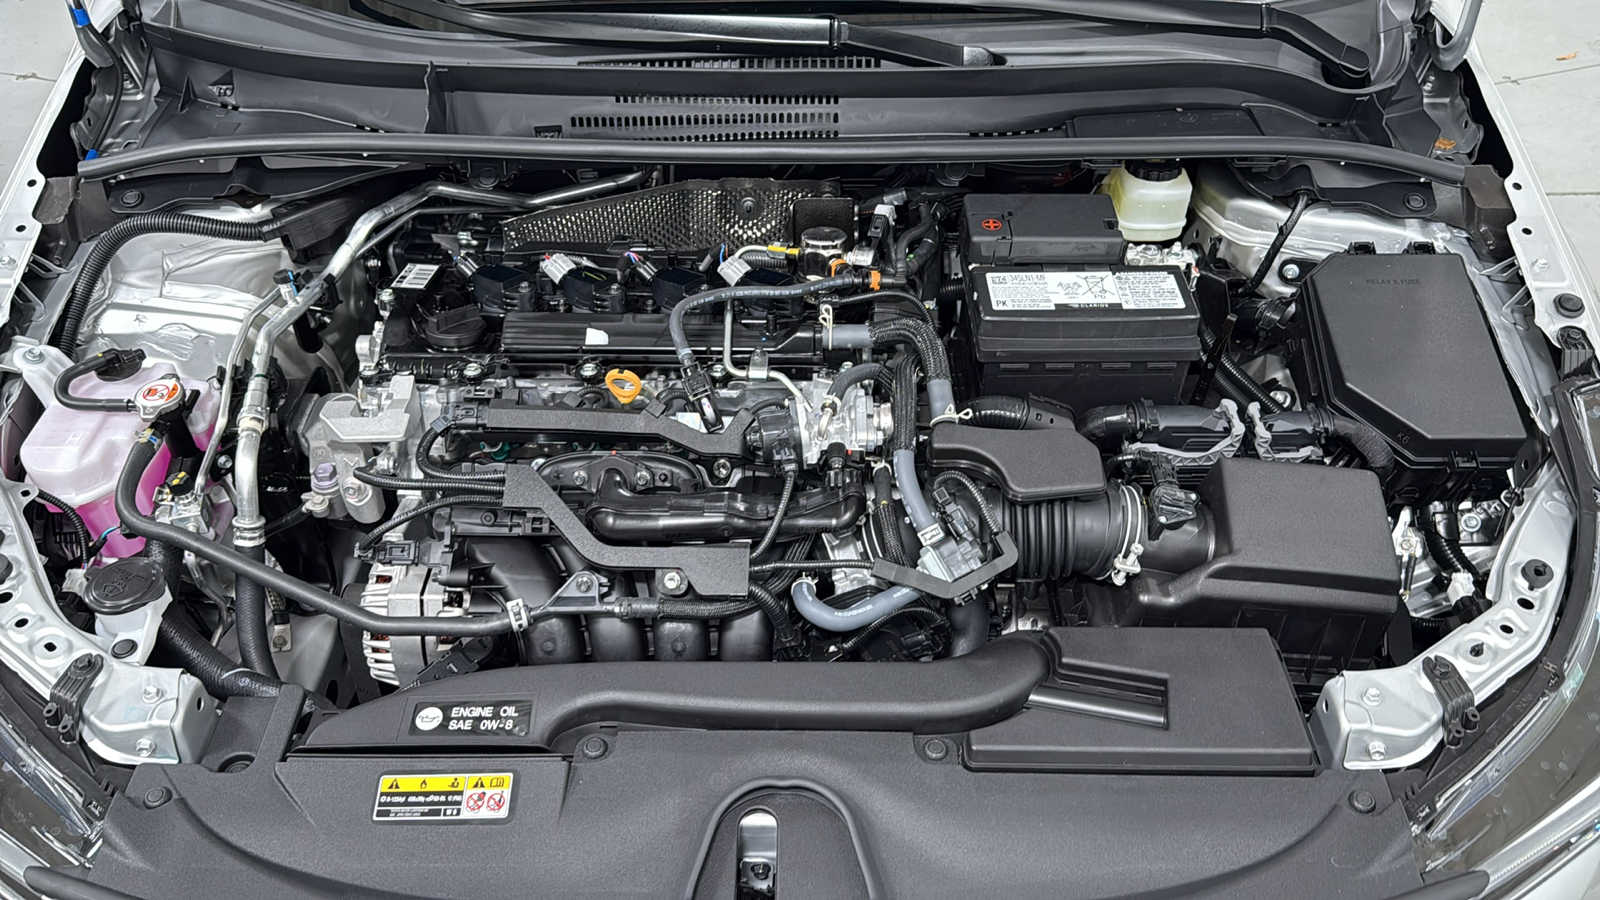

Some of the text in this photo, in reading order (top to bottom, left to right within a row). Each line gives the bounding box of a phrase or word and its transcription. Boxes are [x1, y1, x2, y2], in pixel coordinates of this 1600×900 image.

[995, 299, 1008, 308] PK
[451, 706, 519, 717] ENGINE OIL
[448, 719, 514, 730] SAE 0W-8
